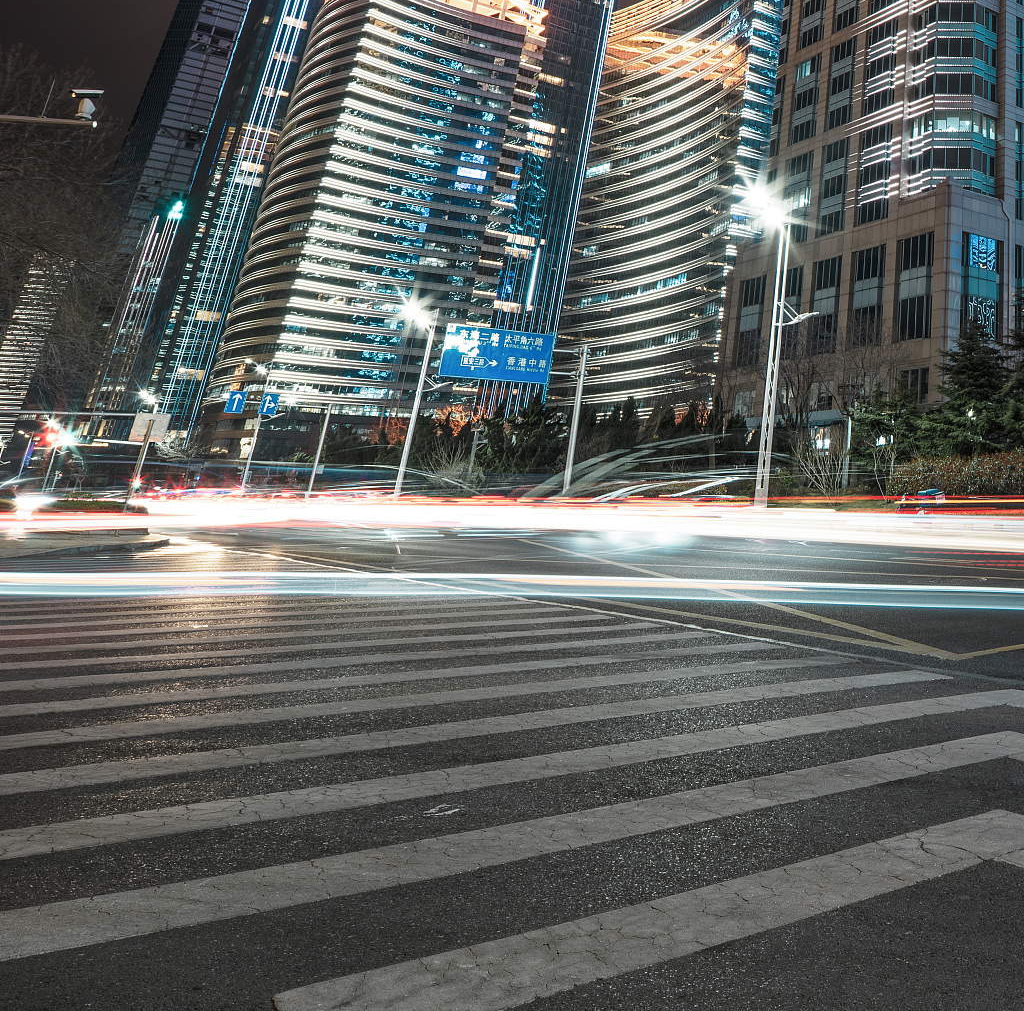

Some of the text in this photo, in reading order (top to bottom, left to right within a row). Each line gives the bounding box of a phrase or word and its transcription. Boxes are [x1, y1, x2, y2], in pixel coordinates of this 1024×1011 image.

[504, 334, 544, 346] 太平角六路
[507, 356, 547, 368] 香港中路
